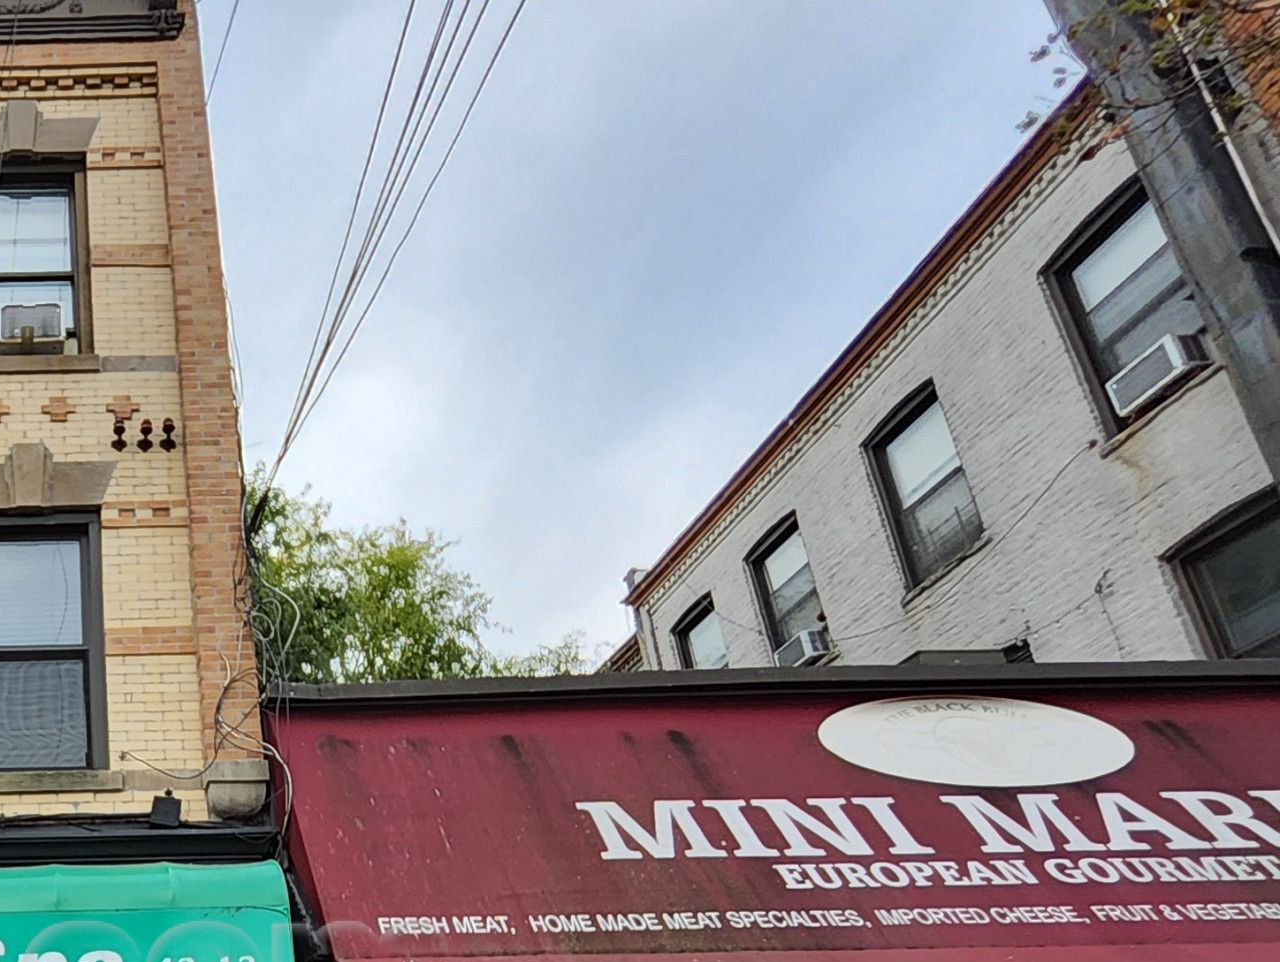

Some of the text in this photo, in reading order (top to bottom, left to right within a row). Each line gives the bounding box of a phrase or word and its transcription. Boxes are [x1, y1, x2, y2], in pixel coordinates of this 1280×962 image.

[913, 702, 977, 714] BLACK
[577, 797, 934, 859] MINI
[771, 854, 1280, 890] EUROPEAN GOURMET
[377, 916, 449, 936] FRESH
[454, 915, 516, 936] MEAT,
[529, 914, 595, 933] HOME
[600, 913, 662, 932] MADE
[662, 911, 721, 931] MEAT
[726, 909, 873, 930] SPECIALTIES,
[874, 907, 990, 926] IMPORTED
[990, 905, 1091, 925] CHEESE,
[1090, 904, 1160, 922] FRUIT
[1159, 904, 1183, 920] &
